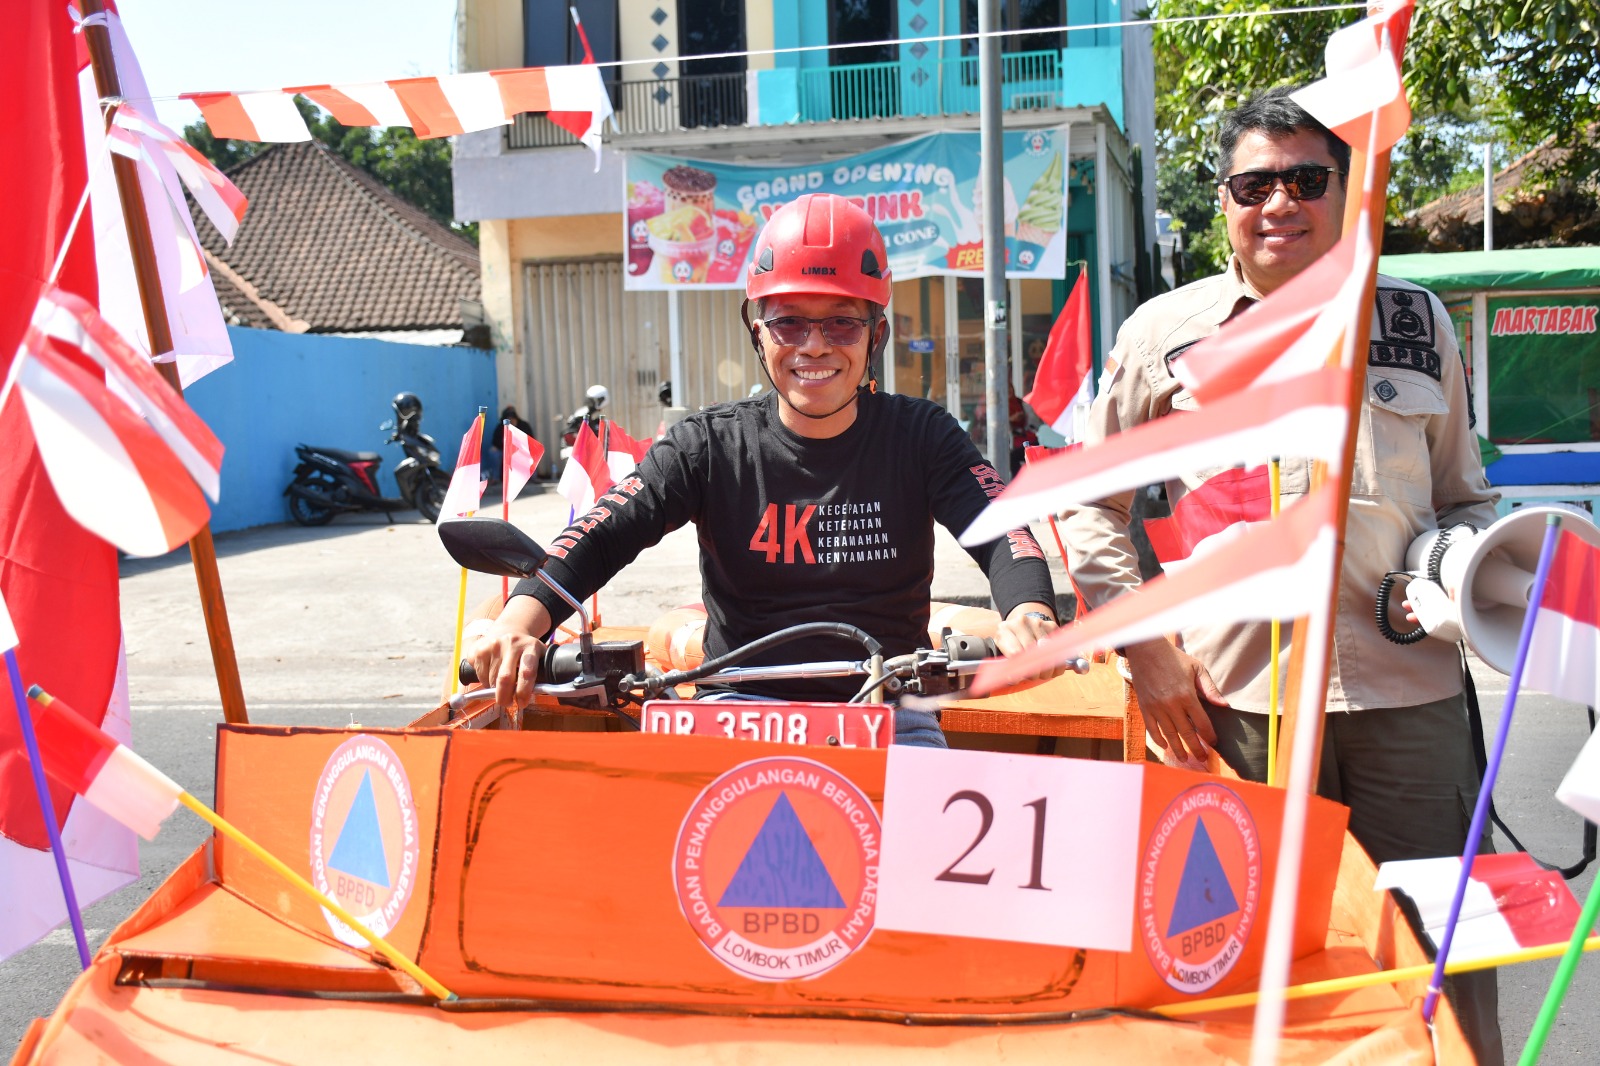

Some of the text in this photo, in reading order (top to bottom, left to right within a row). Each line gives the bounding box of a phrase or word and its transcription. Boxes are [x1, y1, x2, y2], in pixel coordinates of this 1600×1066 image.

[736, 162, 953, 203] GRAND OPENING
[893, 224, 938, 246] CONE
[801, 266, 837, 276] LIMBX
[956, 248, 984, 267] FRE
[1491, 305, 1599, 336] MARTABAK
[1377, 345, 1438, 371] BPBD
[818, 501, 881, 516] KECEPATAN
[818, 517, 882, 532] KETEPATAN
[749, 502, 817, 565] 4K
[818, 533, 889, 548] KERAMAHAN
[818, 547, 898, 564] KENYAMANAN
[717, 711, 808, 745] 3508
[314, 745, 414, 921] BADAN PENANGGULANGAN BENCANA DAERAH
[934, 789, 1053, 892] 21
[685, 768, 880, 941] BADAN PENANGGULANGAN BENCANA DAERAH
[336, 875, 376, 908] BPBD
[1143, 792, 1257, 970] BADAN PENANGGULANGAN BENCANA DAERAH
[743, 912, 820, 935] BPBD
[1181, 922, 1226, 957] BPBD
[722, 937, 843, 970] LOMBOK TIMUR
[1172, 939, 1240, 985] LOMBOK TIMUR
